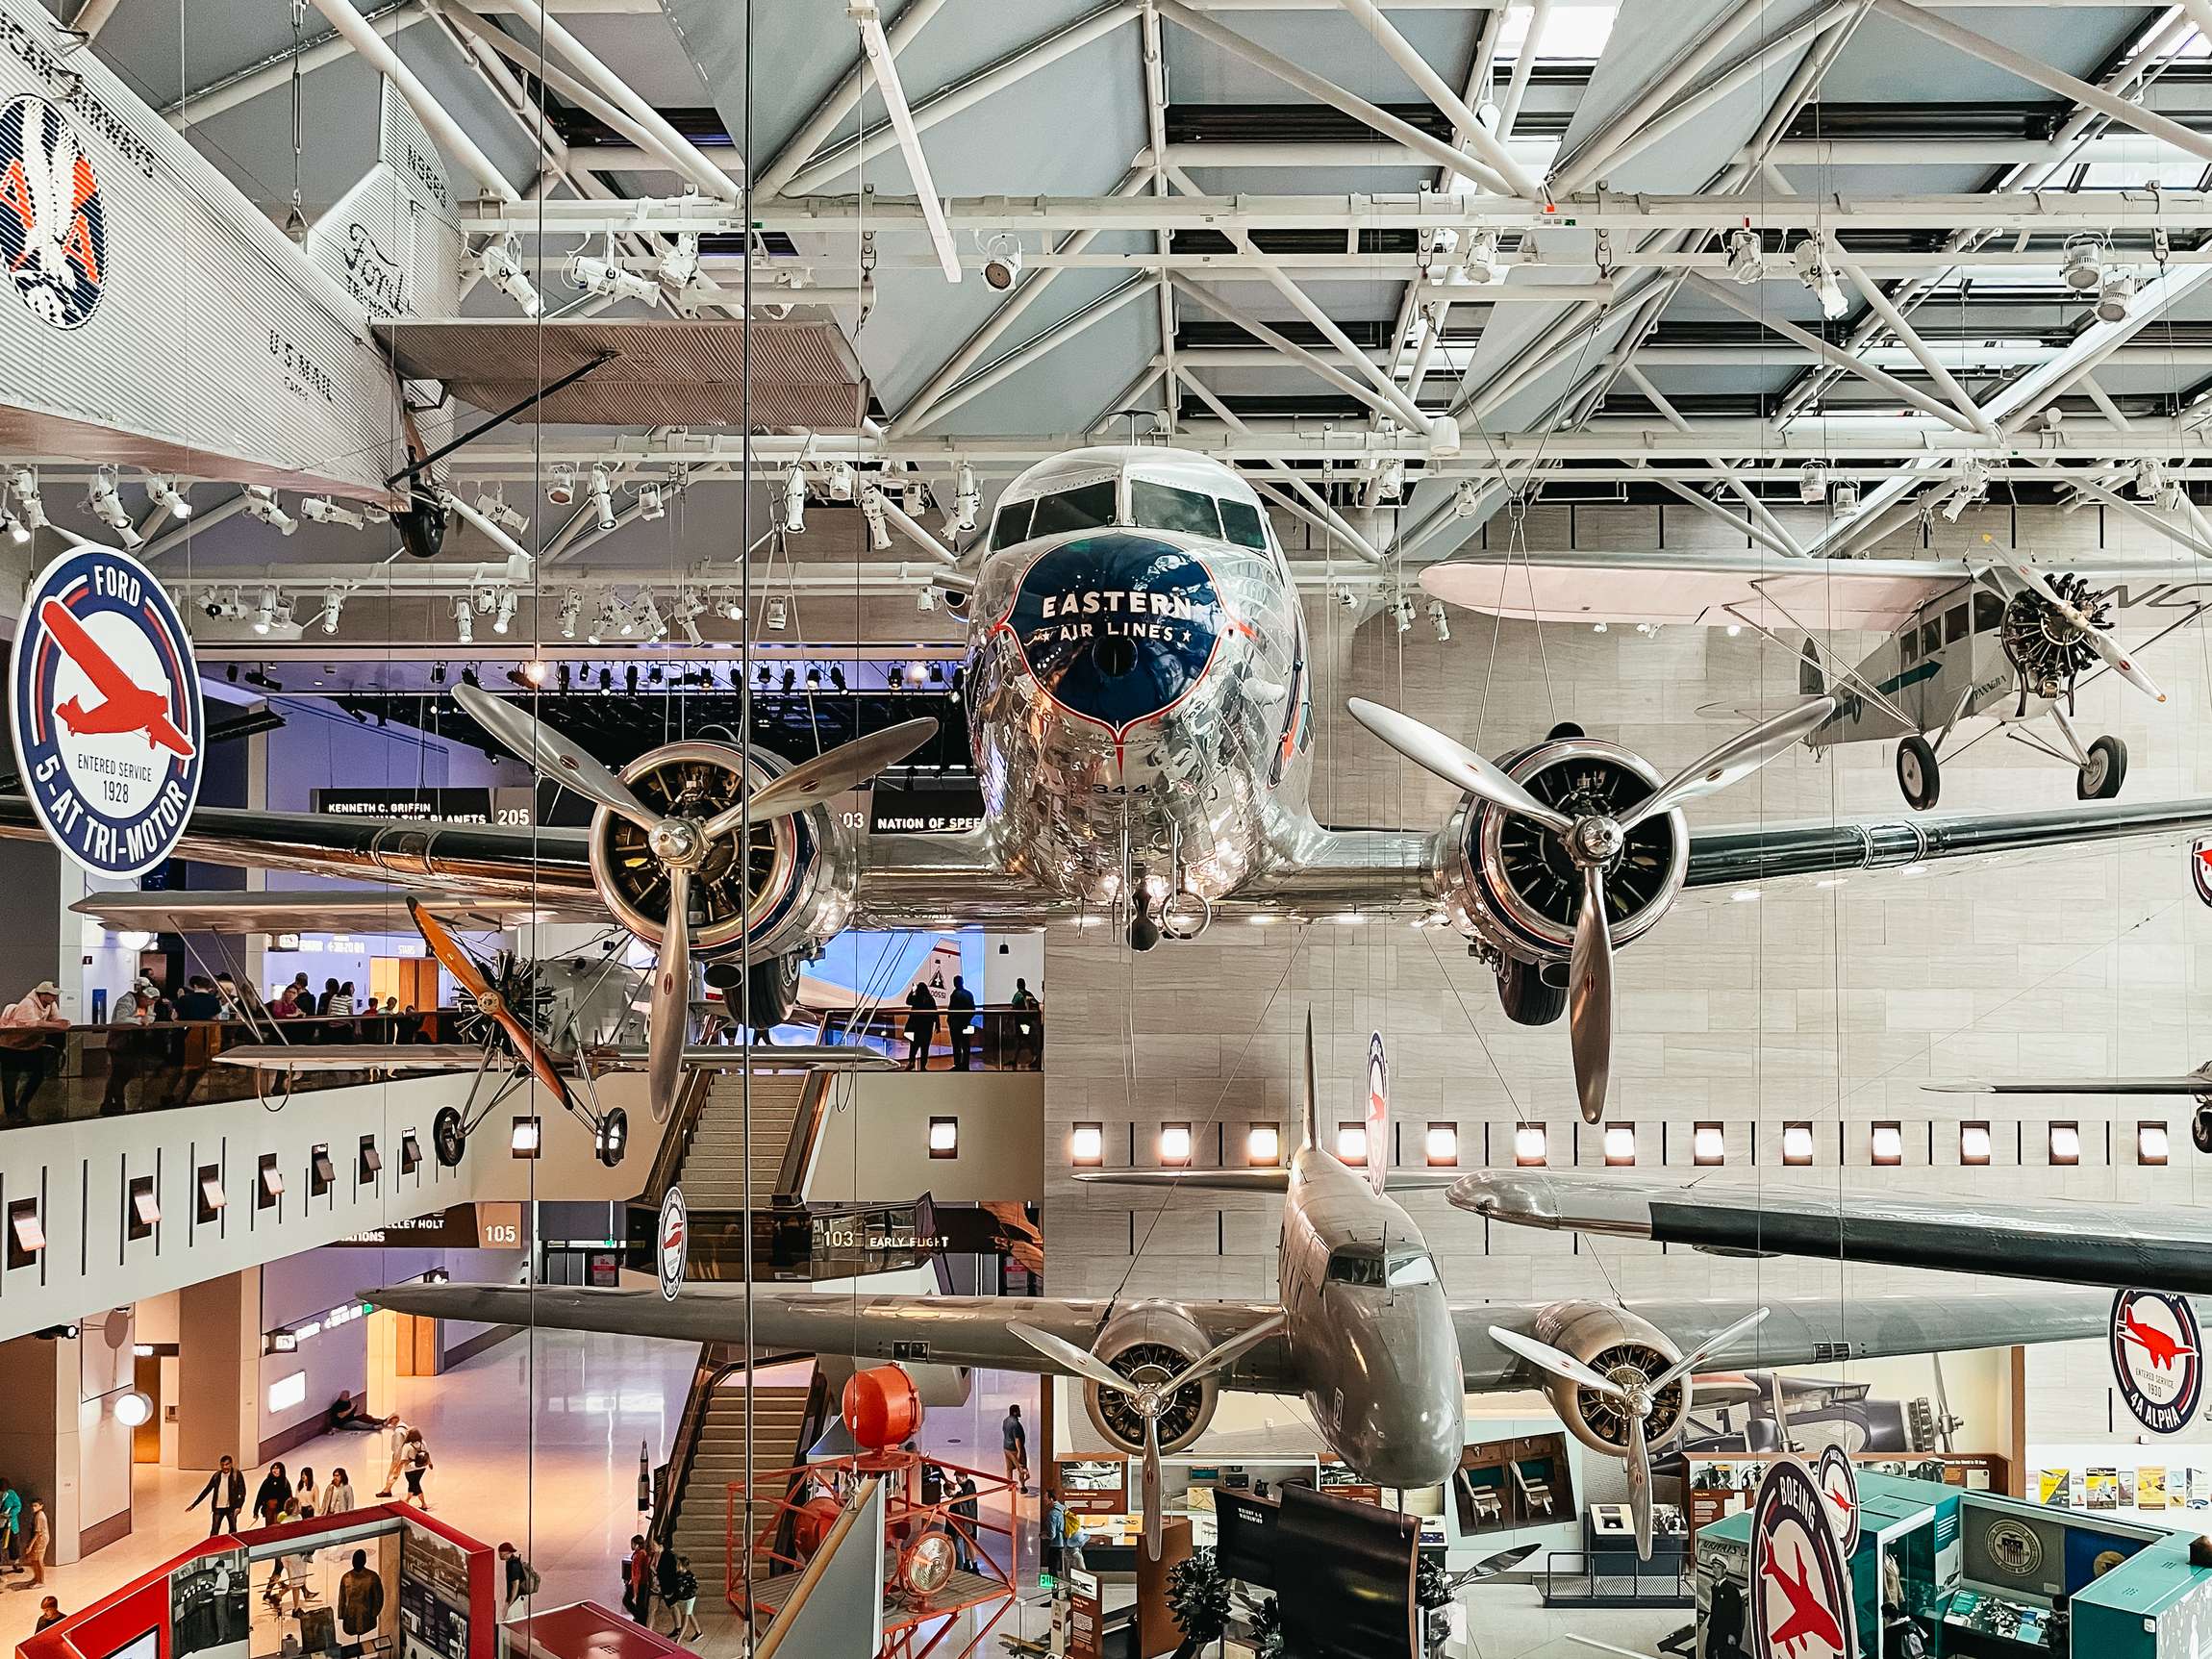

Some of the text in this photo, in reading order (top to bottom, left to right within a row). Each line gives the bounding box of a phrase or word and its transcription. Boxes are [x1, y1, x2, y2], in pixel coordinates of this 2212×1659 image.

[93, 565, 141, 607] FORD
[1043, 591, 1193, 618] EASTERN
[1060, 622, 1173, 641] AIR LINES
[77, 753, 152, 783] ENTERED SERVICE
[103, 779, 130, 804] 1928
[1092, 784, 1150, 795] 344
[36, 754, 188, 865] 5-AT TRI-MOTOR
[328, 803, 431, 814] KENNETH C. GRIFFIN
[497, 808, 530, 826] 205
[839, 812, 865, 829] 03
[877, 817, 982, 830] NATION OF SPEE
[417, 1219, 445, 1229] HOLT
[485, 1225, 516, 1243] 105
[823, 1230, 854, 1247] 103
[869, 1237, 904, 1247] EARLY
[2135, 1367, 2174, 1390] ENTERED SERVICE
[2148, 1382, 2162, 1397] 1930
[2130, 1392, 2181, 1429] 4A ALPHA
[1779, 1475, 1817, 1532] BOEING
